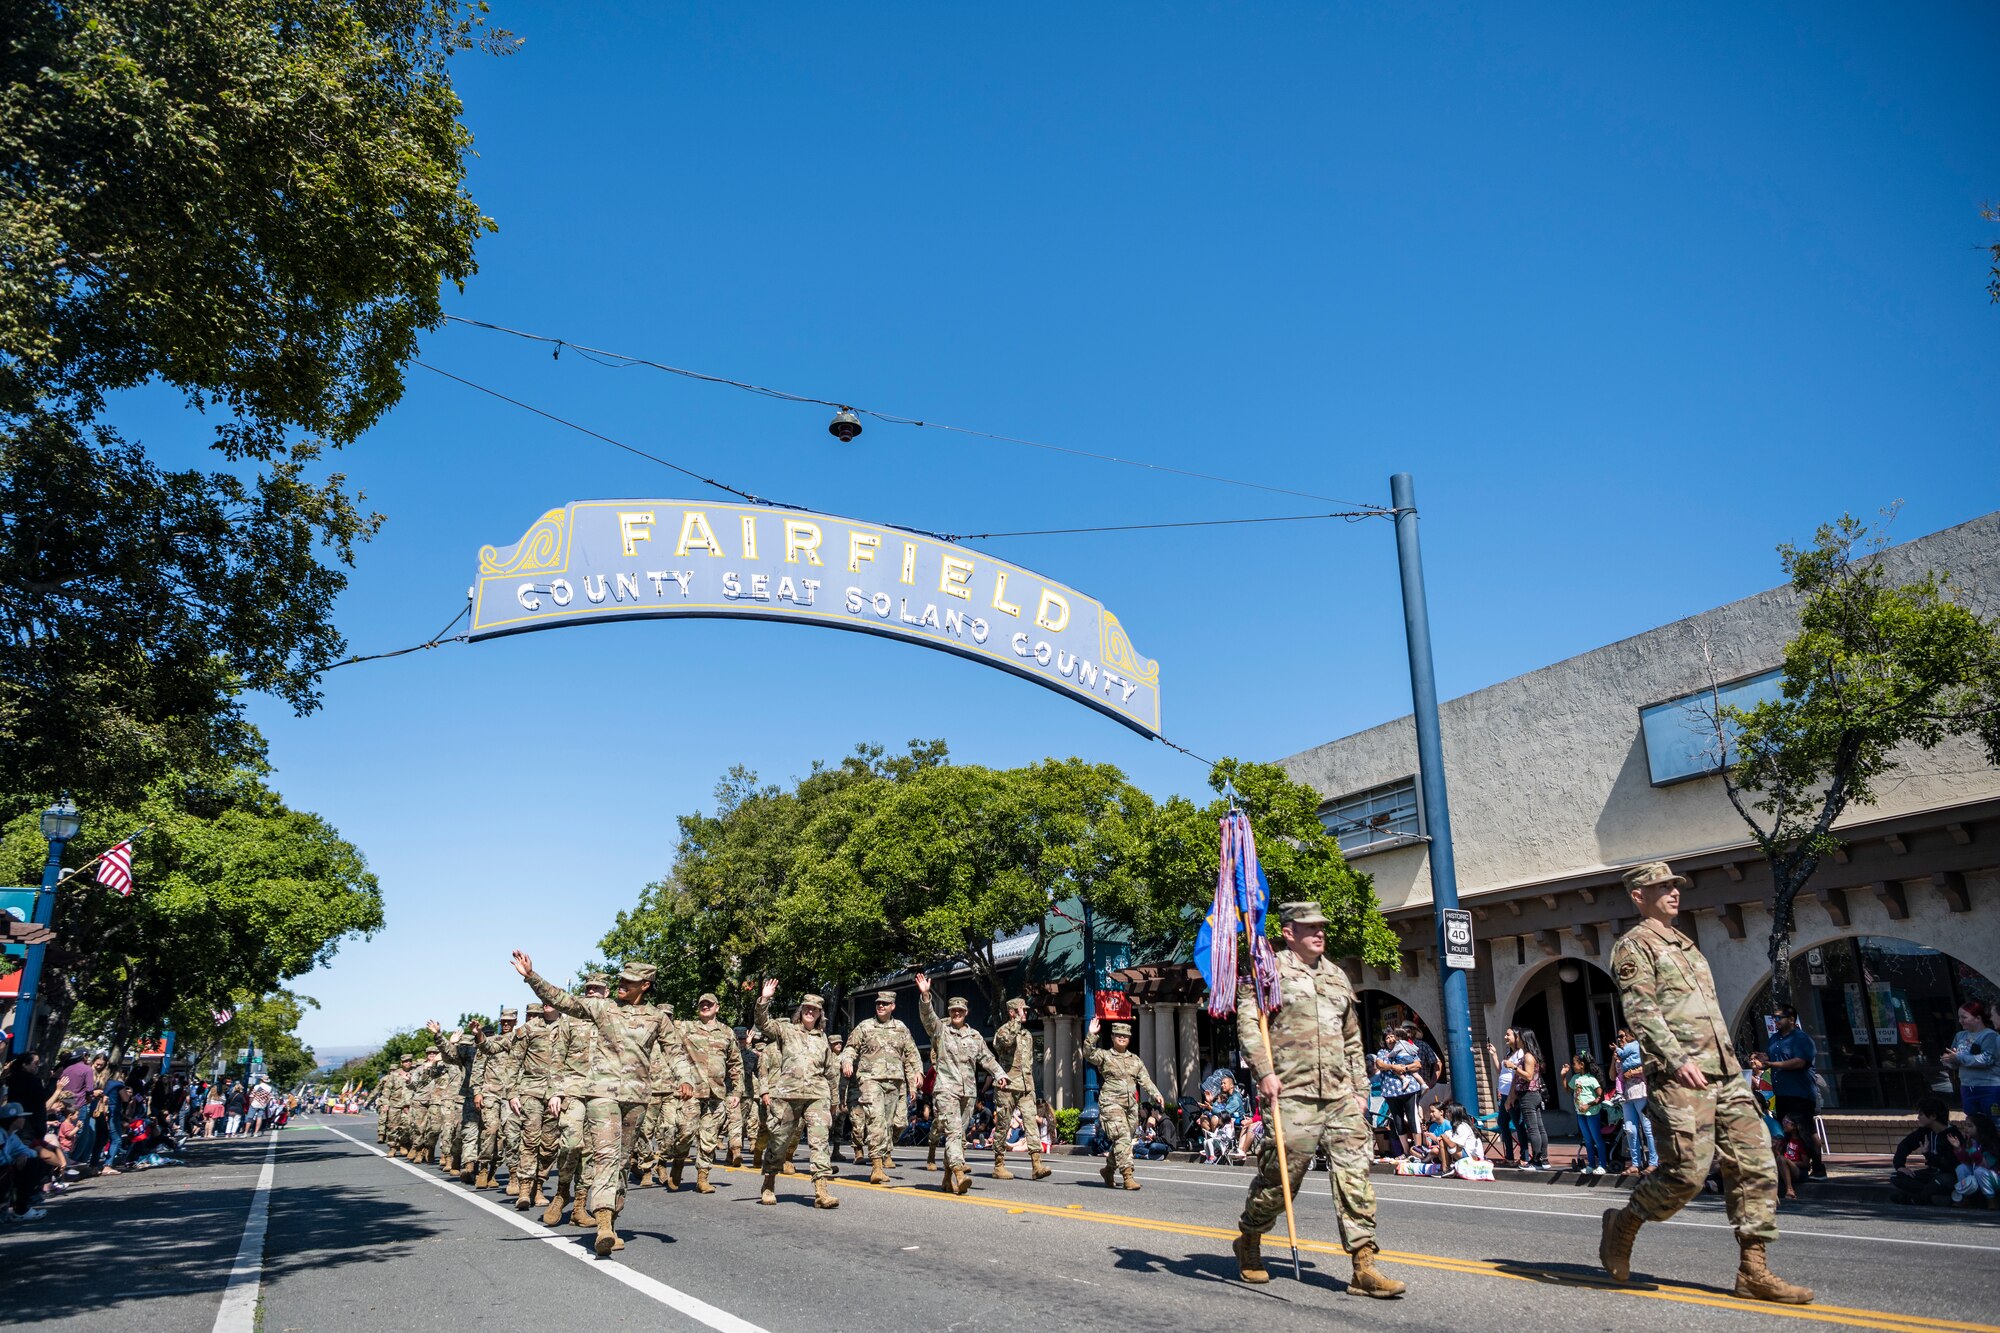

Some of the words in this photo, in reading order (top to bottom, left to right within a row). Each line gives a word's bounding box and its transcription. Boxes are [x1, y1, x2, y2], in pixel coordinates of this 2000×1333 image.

[616, 510, 1070, 632] FAIRFIELD
[517, 570, 694, 611] COUNTY
[722, 571, 821, 605] SEAT
[845, 586, 990, 643] SOLANO
[1011, 632, 1138, 704] COUNTY
[1445, 912, 1469, 921] HISTORIC
[1452, 930, 1466, 940] 40
[1451, 945, 1468, 953] ROUTE
